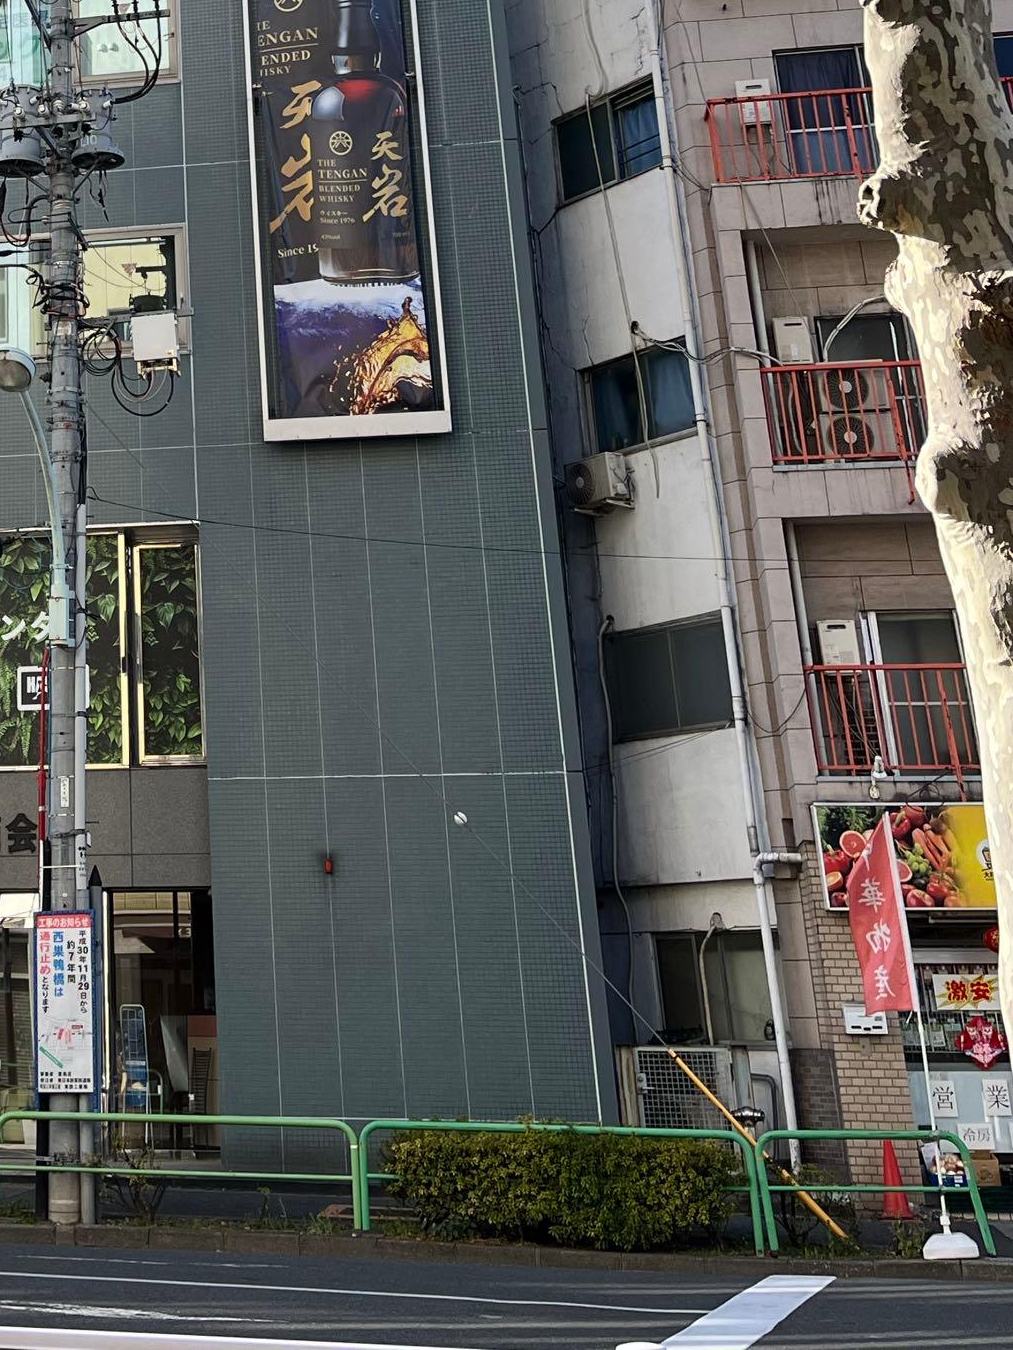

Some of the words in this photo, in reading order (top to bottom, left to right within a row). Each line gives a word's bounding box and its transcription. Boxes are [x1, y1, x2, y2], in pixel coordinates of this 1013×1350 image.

[258, 27, 318, 47] ENGAN
[261, 49, 311, 66] ENDED
[317, 158, 337, 167] THE
[317, 167, 368, 179] TENGAN
[318, 184, 361, 193] BLENDED
[278, 246, 305, 259] Since
[39, 917, 89, 928] 工事のお知らせ
[66, 940, 76, 984] 約7年間
[945, 979, 991, 1002] 激安
